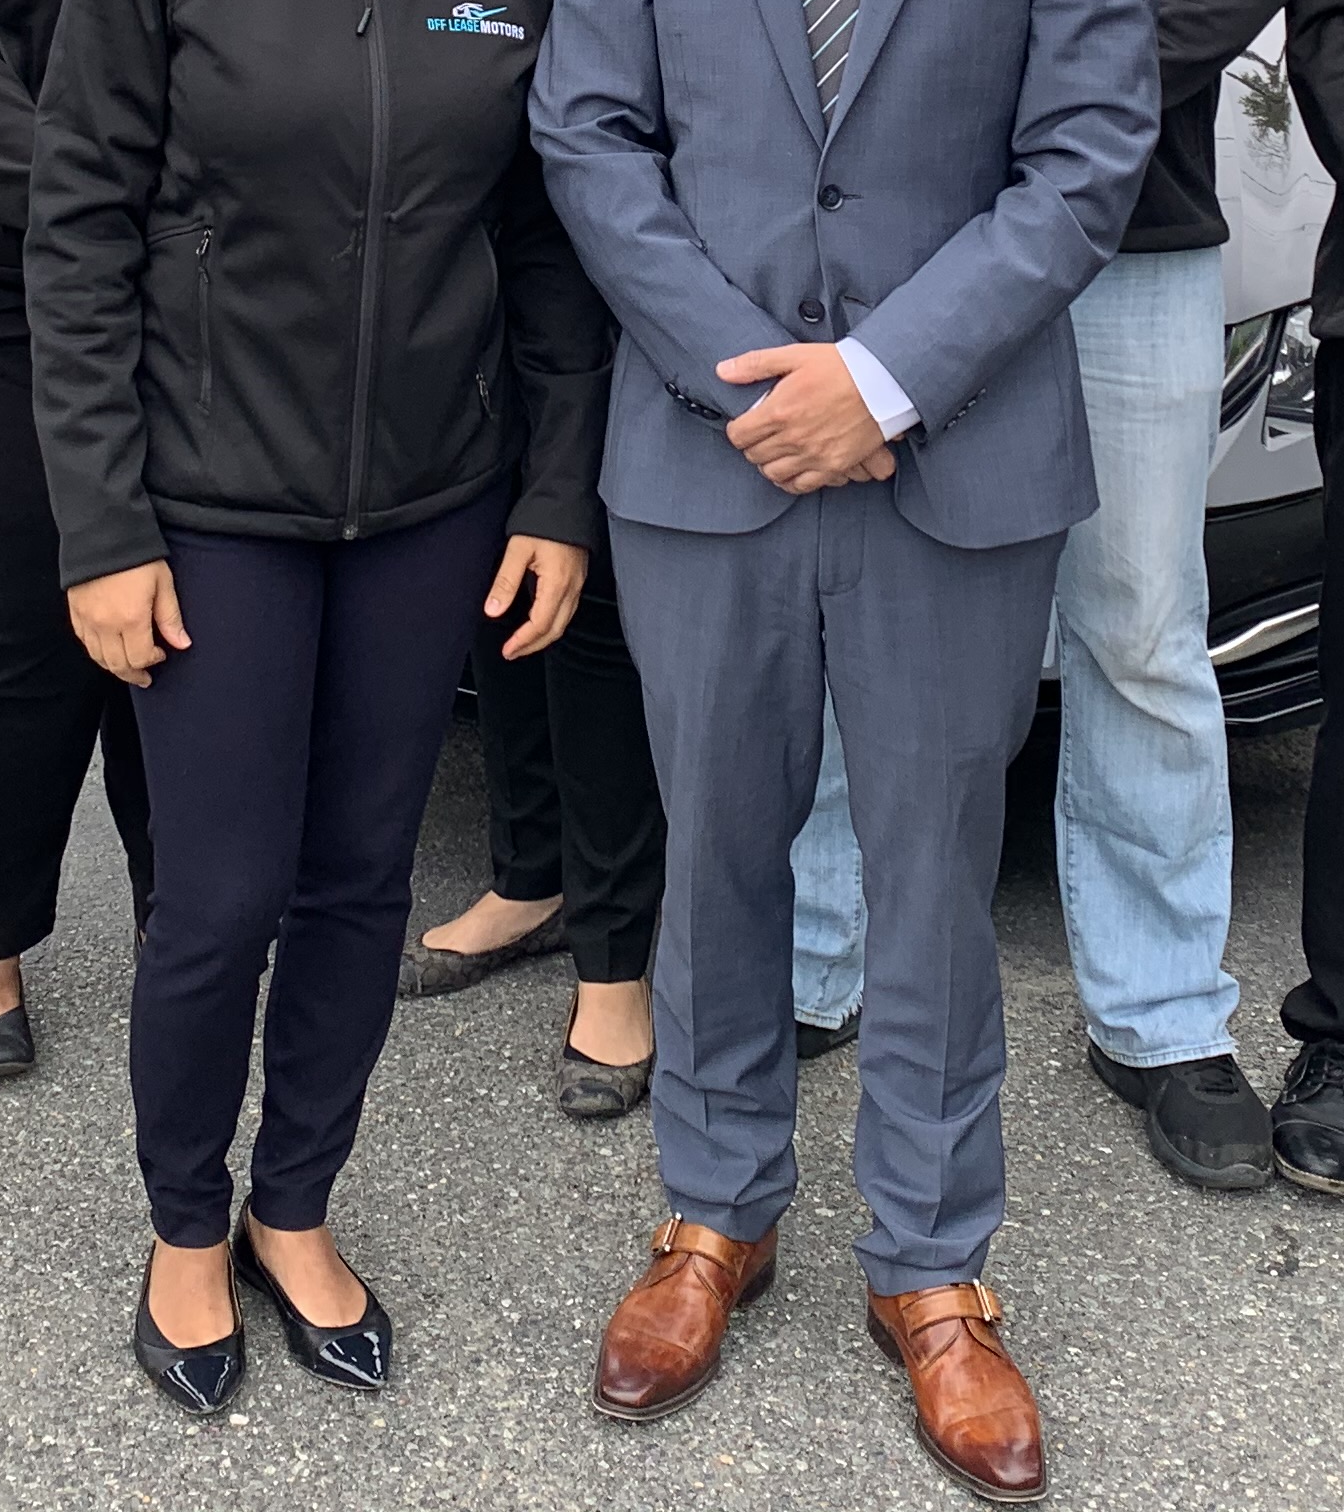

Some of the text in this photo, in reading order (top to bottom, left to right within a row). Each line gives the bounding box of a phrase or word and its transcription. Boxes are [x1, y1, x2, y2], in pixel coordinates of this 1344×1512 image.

[427, 18, 525, 40] OFF LEASE MOTORS
